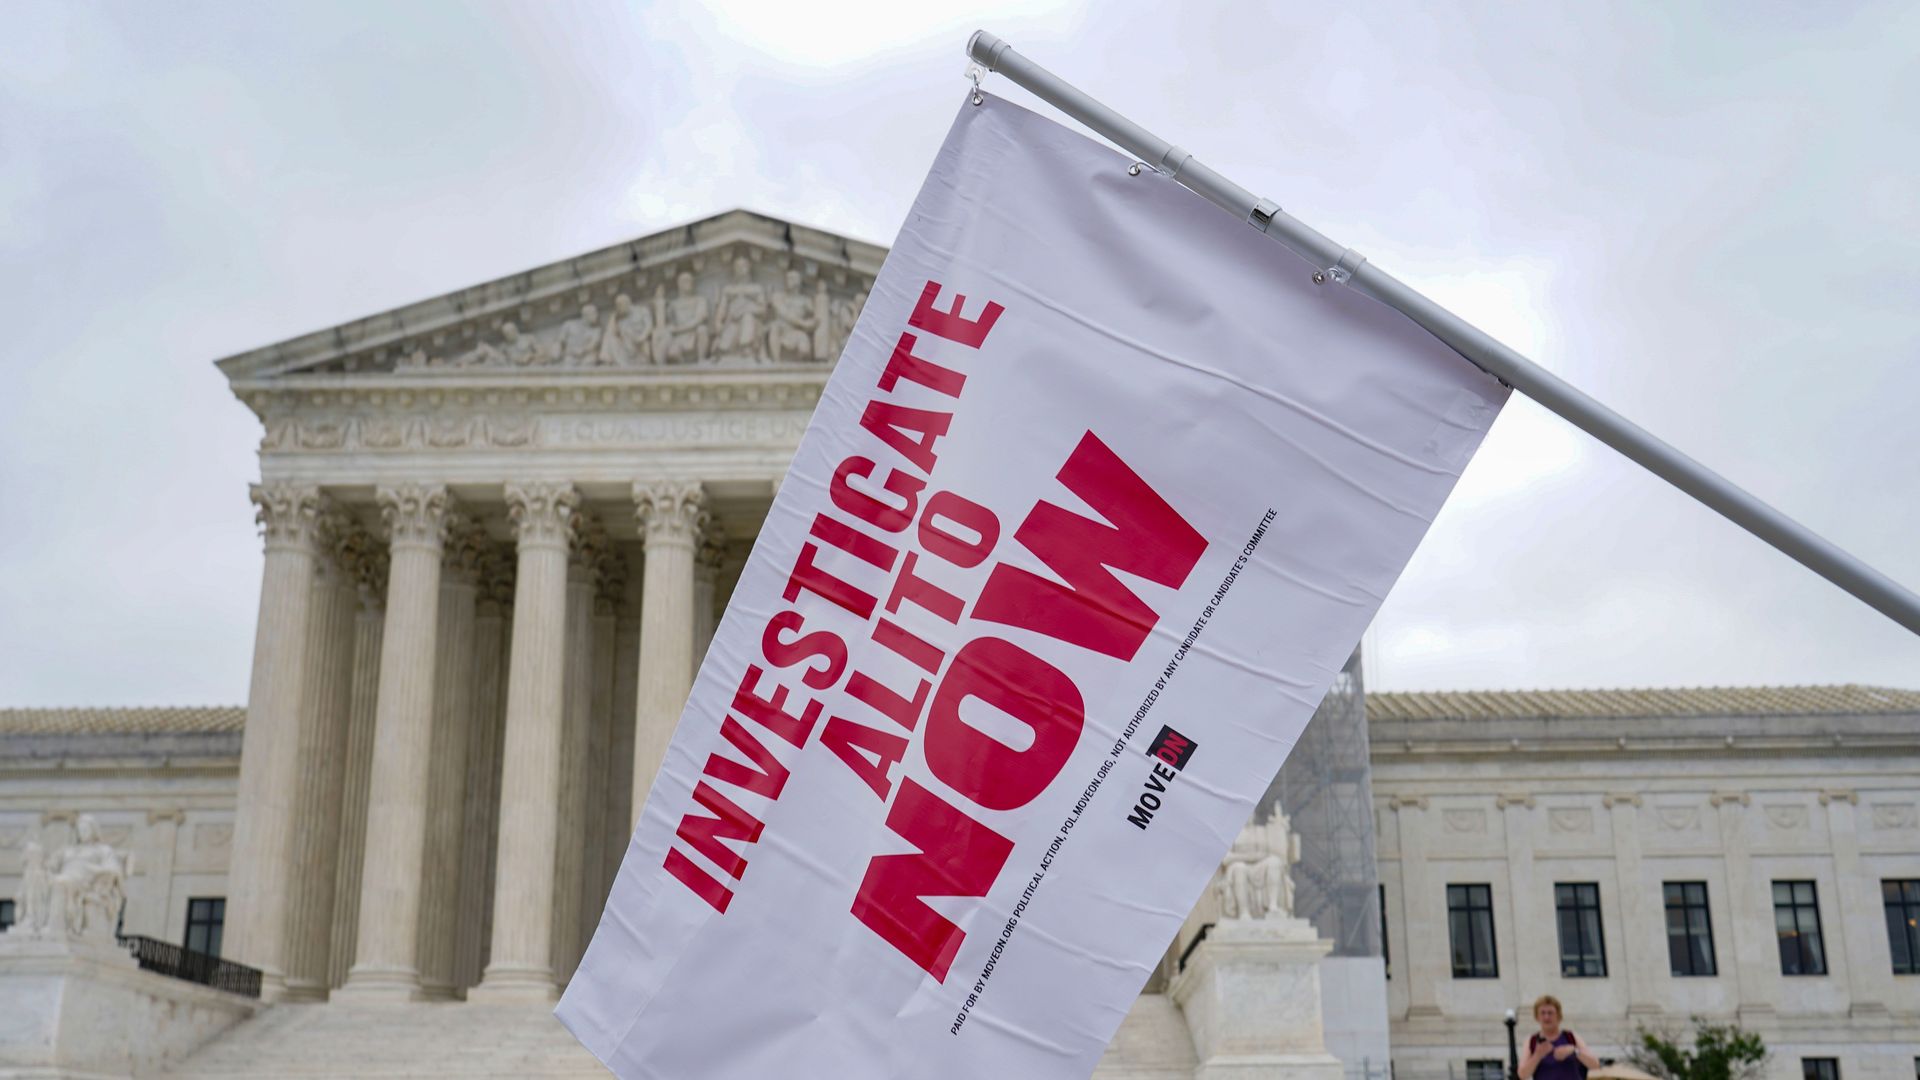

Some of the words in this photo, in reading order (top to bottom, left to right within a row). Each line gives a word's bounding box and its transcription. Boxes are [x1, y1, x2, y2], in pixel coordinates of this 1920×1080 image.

[560, 419, 649, 442] EQUAL
[655, 417, 757, 442] JUSTICE
[663, 281, 1004, 913] INVESTIGATE
[820, 491, 1000, 801] ALITO
[850, 430, 1208, 984] NOW
[951, 1013, 966, 1036] PAID
[962, 993, 978, 1013] FOR
[974, 978, 985, 993] BY
[981, 917, 1017, 980] MOVEON.ORG
[1013, 873, 1044, 918] POLITICAL
[1040, 836, 1067, 871] ACTION,
[1061, 760, 1116, 835] POL.MOVEON.ORG,
[1111, 738, 1127, 757] NOT
[1123, 689, 1159, 740] AUTHORIZED
[1155, 676, 1166, 690] BY
[1164, 659, 1178, 679] ANY
[1175, 617, 1207, 660] CANDIDATE
[1203, 606, 1215, 618] OR
[1211, 555, 1247, 606] CANDIDATE'S
[1243, 508, 1277, 555] COMMITTEE
